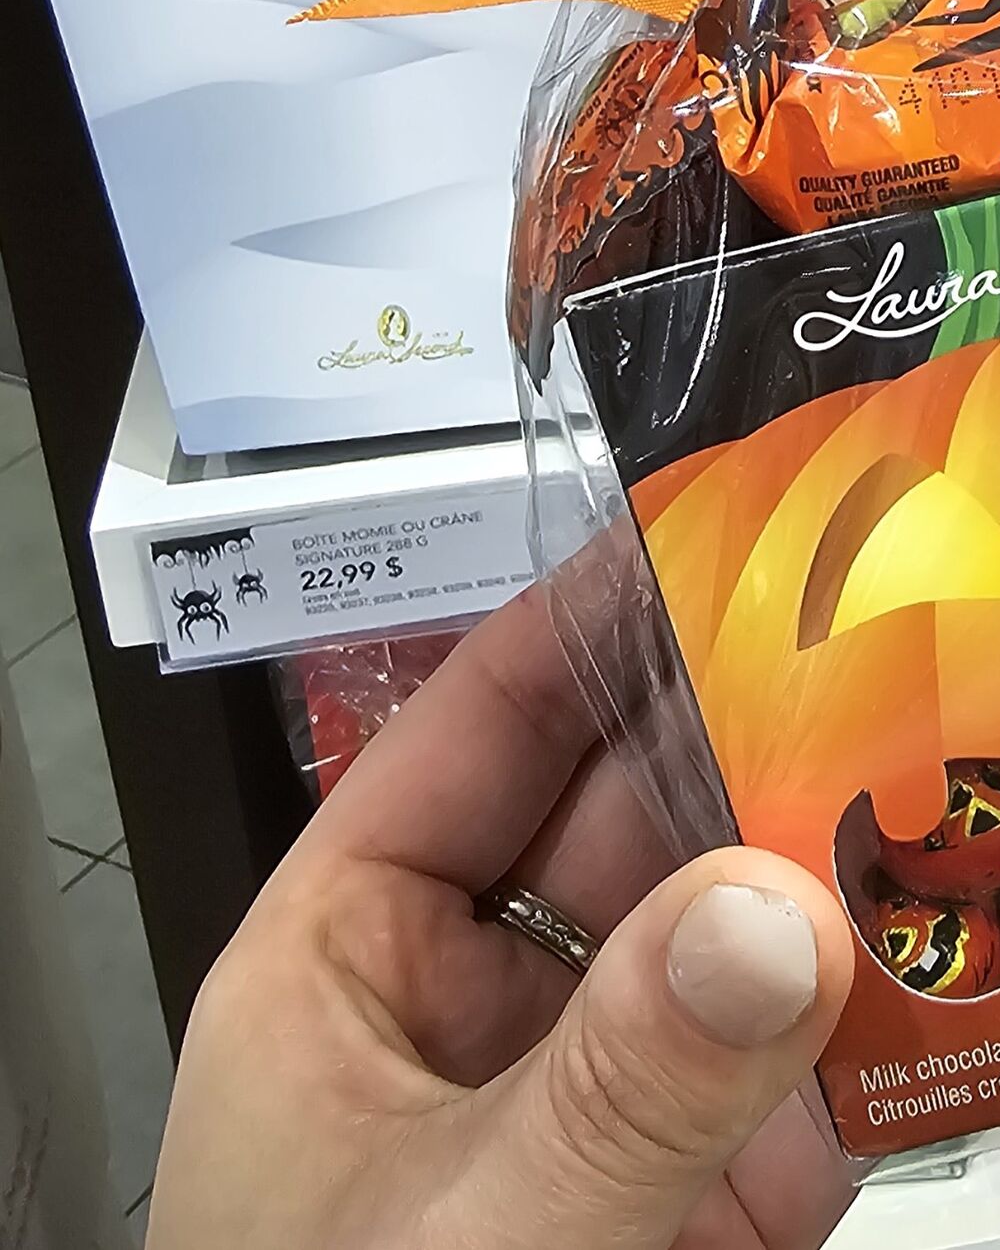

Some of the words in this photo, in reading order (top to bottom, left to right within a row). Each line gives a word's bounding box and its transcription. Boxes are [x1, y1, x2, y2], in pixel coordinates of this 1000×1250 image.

[799, 173, 858, 194] QUALITY
[860, 153, 961, 190] GUARANTEED
[877, 176, 950, 203] GARANTIE
[291, 531, 338, 551] BOÎTE
[341, 522, 397, 545] MOMIE
[400, 520, 427, 534] OU
[429, 509, 485, 530] CRÂNE
[294, 541, 383, 568] SIGNATURE
[415, 534, 430, 548] G
[300, 561, 377, 592] 22,99
[385, 556, 404, 580] $
[858, 1063, 912, 1094] Milk
[866, 1082, 974, 1127] Citrouilles
